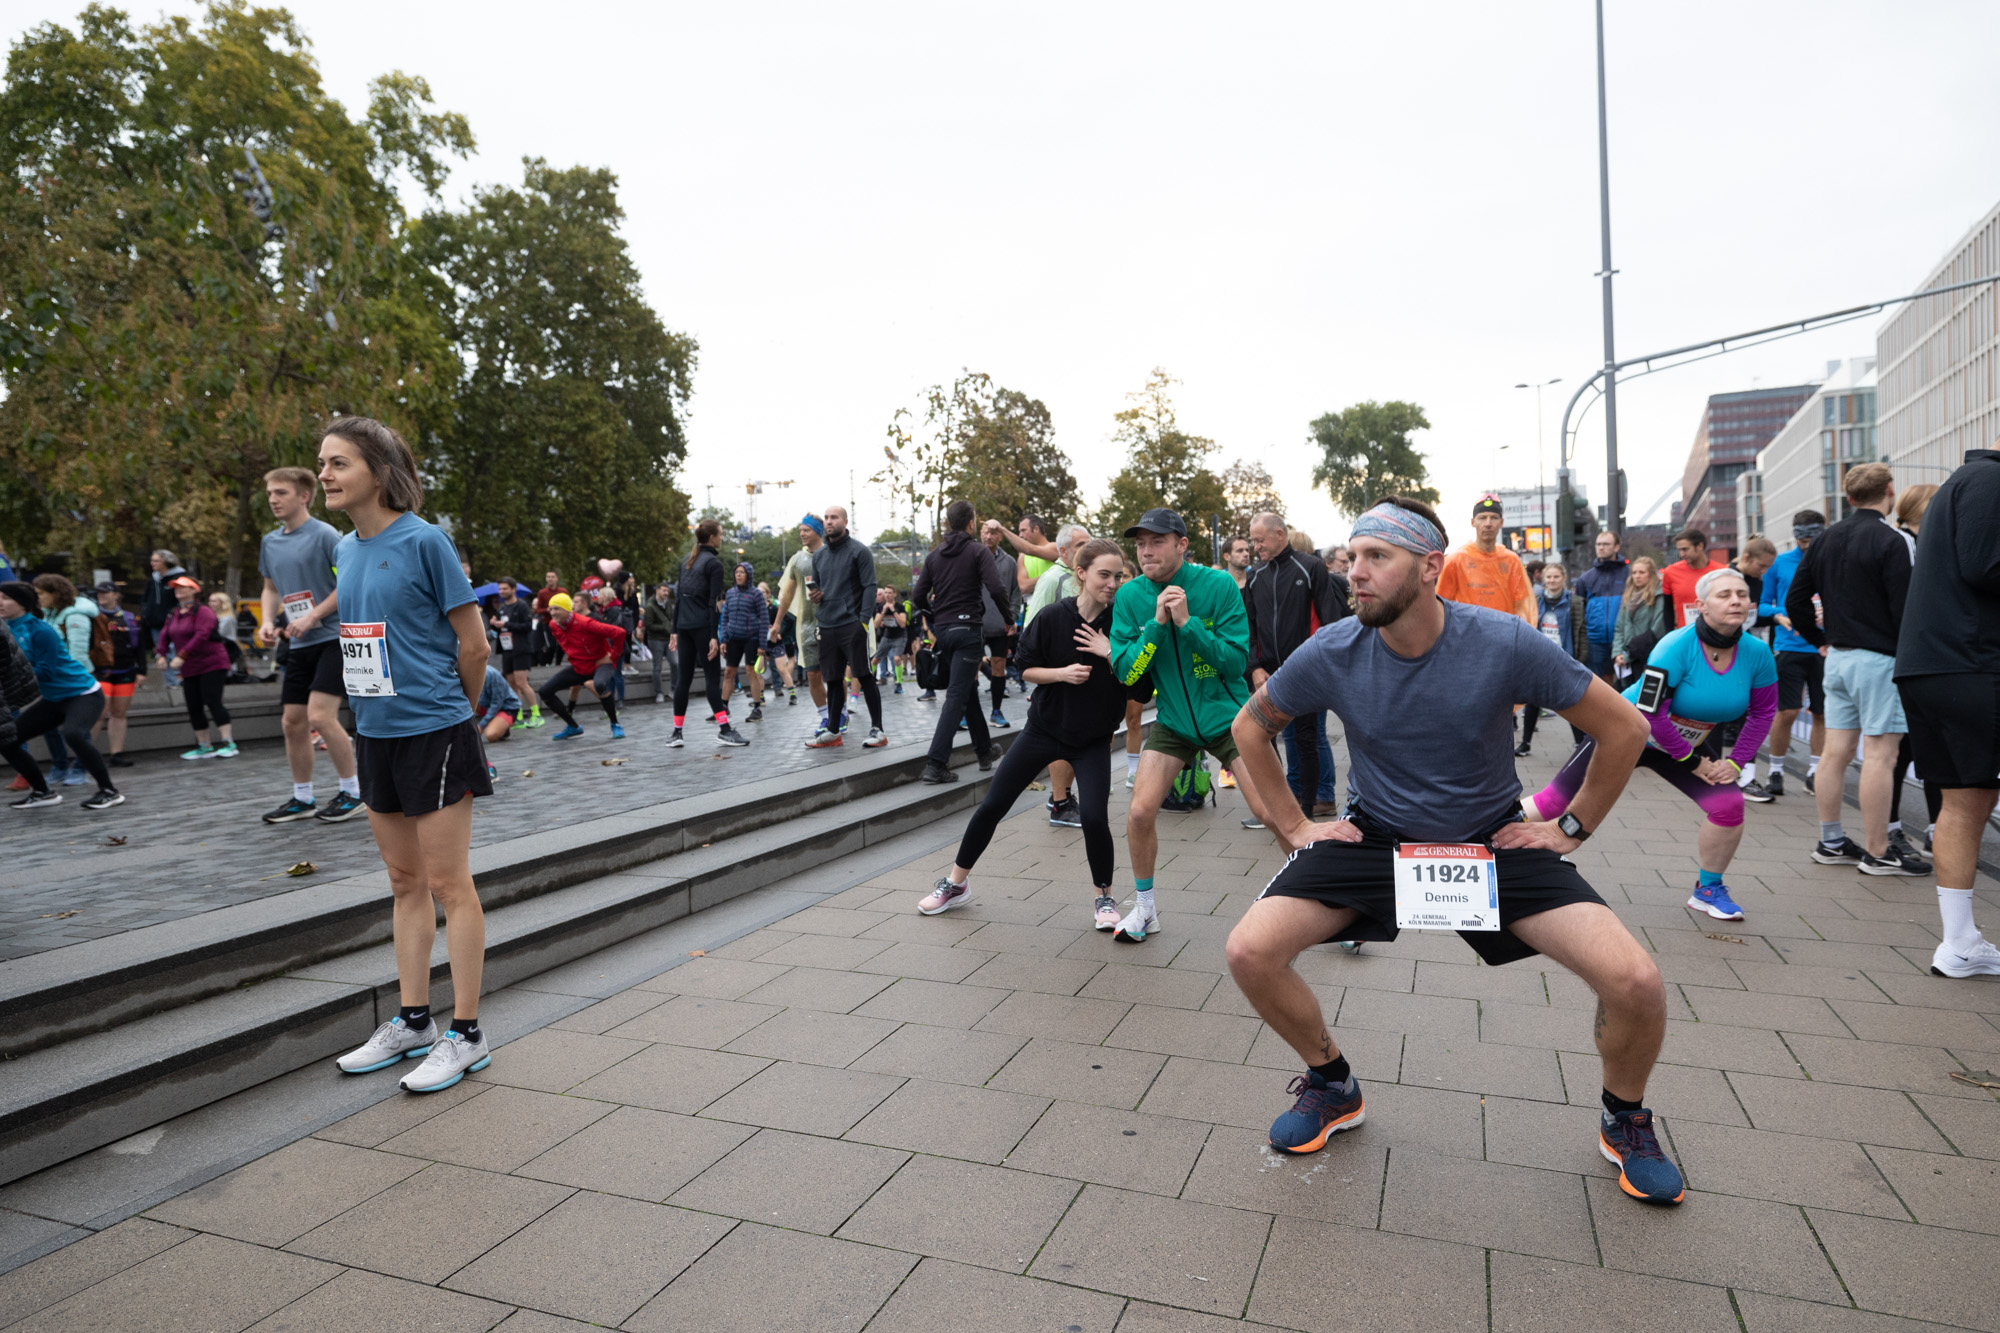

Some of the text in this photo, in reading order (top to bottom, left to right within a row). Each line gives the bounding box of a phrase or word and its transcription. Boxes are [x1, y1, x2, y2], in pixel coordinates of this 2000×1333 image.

[345, 667, 374, 675] ominike
[1674, 725, 1703, 740] 1291
[1428, 847, 1478, 857] GENERALI
[1412, 864, 1480, 883] 11924
[1425, 892, 1469, 903] Dennis
[1461, 919, 1482, 927] PUMA
